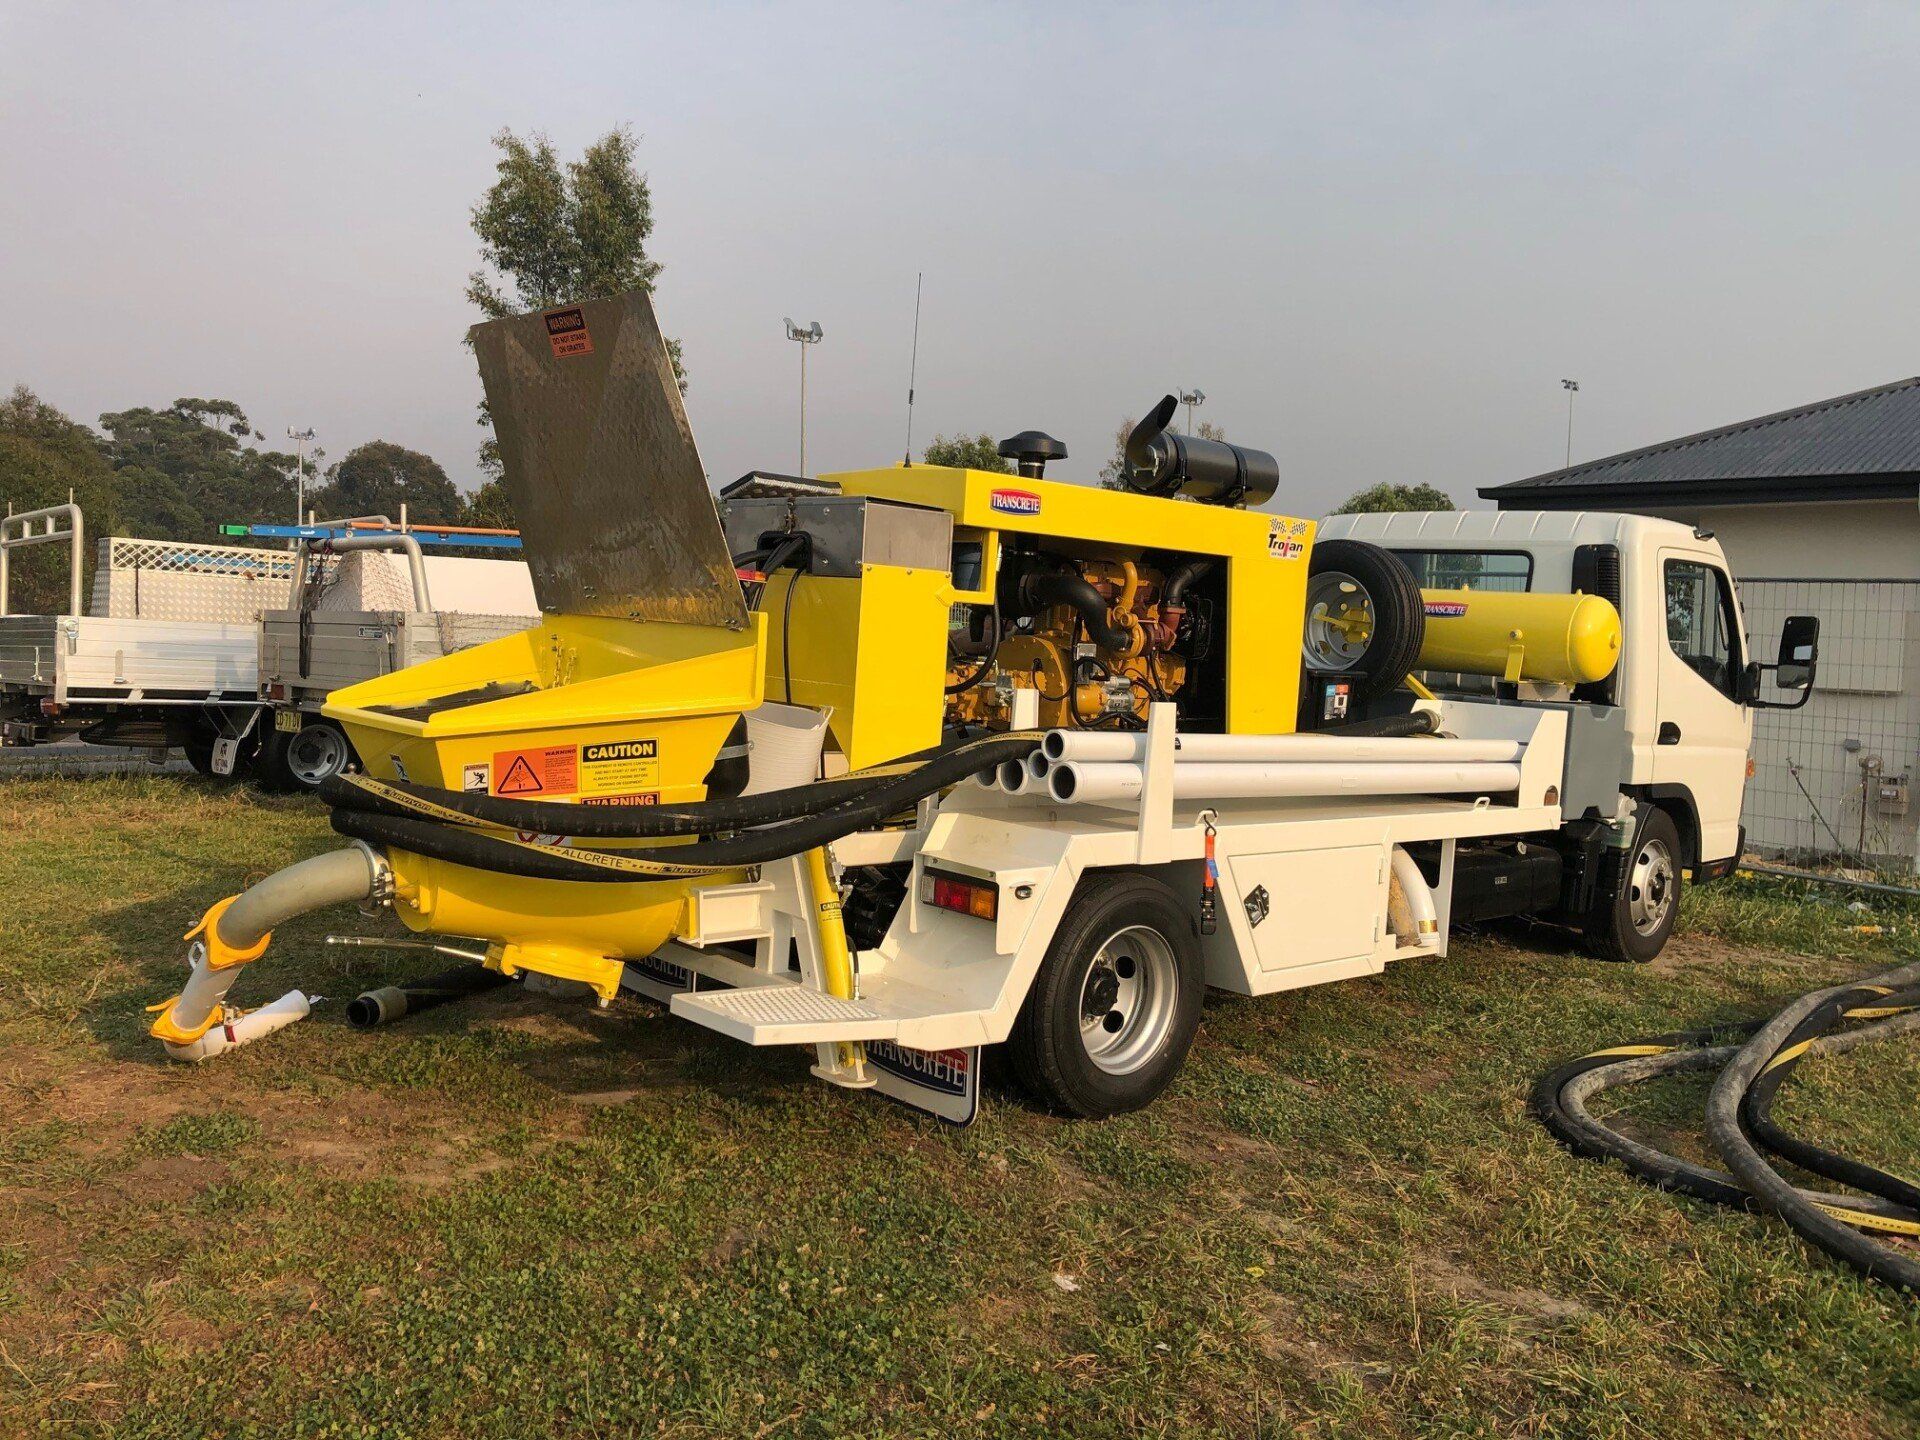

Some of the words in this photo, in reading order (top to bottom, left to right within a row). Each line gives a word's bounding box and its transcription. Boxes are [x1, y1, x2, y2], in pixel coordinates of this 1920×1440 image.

[548, 314, 580, 329] WARNING
[552, 337, 560, 345] DO
[569, 332, 587, 341] STAND
[992, 494, 1040, 512] TRANSCRETE
[1268, 534, 1303, 557] Trojan
[587, 743, 654, 759] CAUTION
